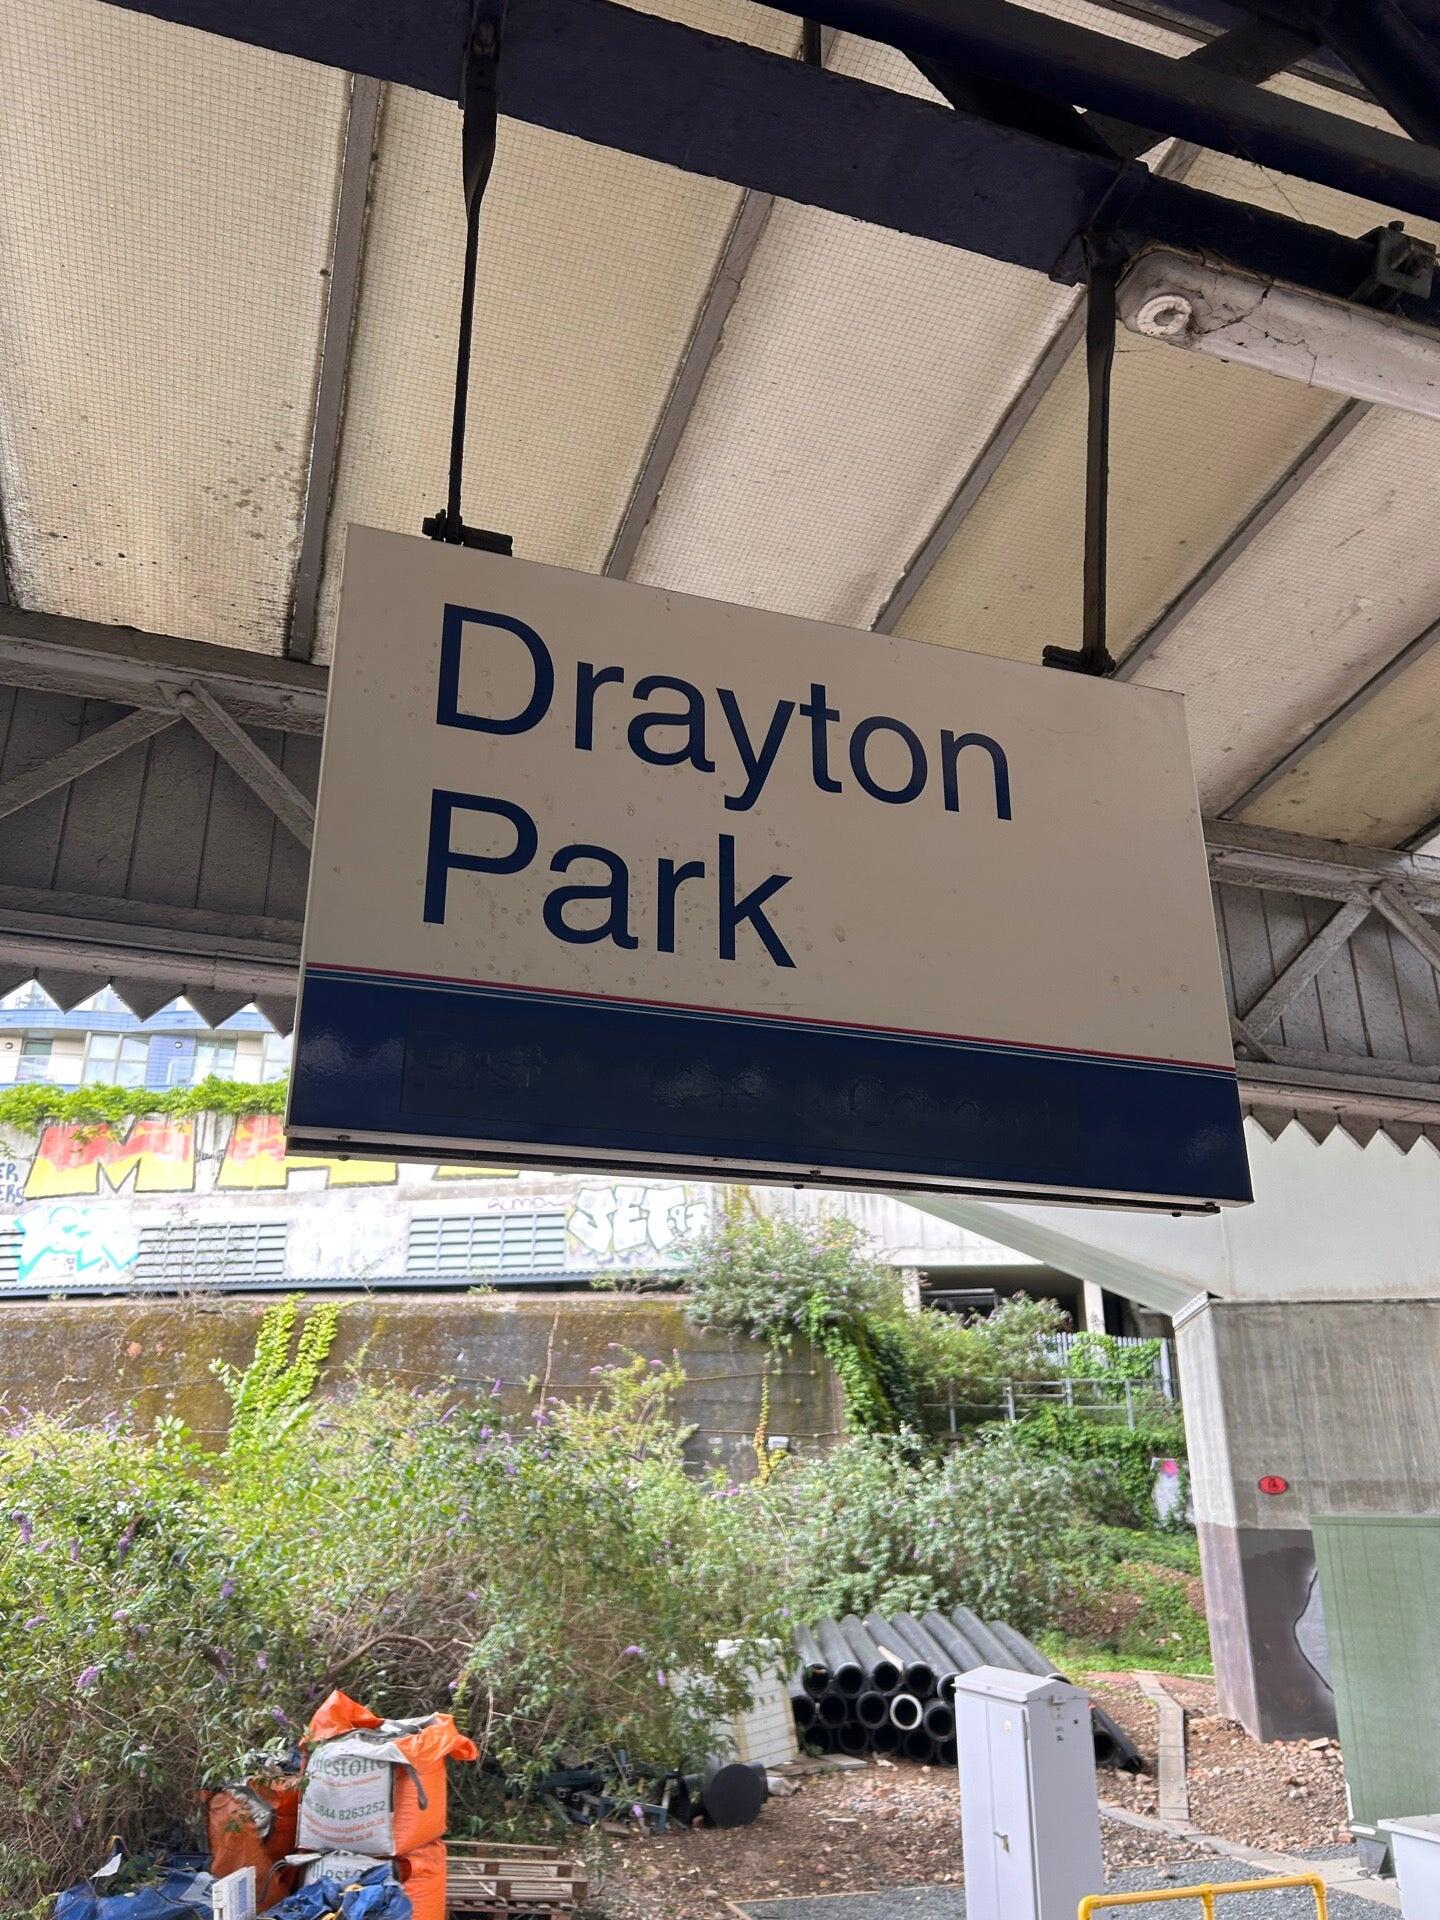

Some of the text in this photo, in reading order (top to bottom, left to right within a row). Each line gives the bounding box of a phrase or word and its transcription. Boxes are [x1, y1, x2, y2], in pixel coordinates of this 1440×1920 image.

[437, 603, 1012, 820] Drayton
[422, 789, 797, 968] Park
[338, 1800, 386, 1821] 8263252
